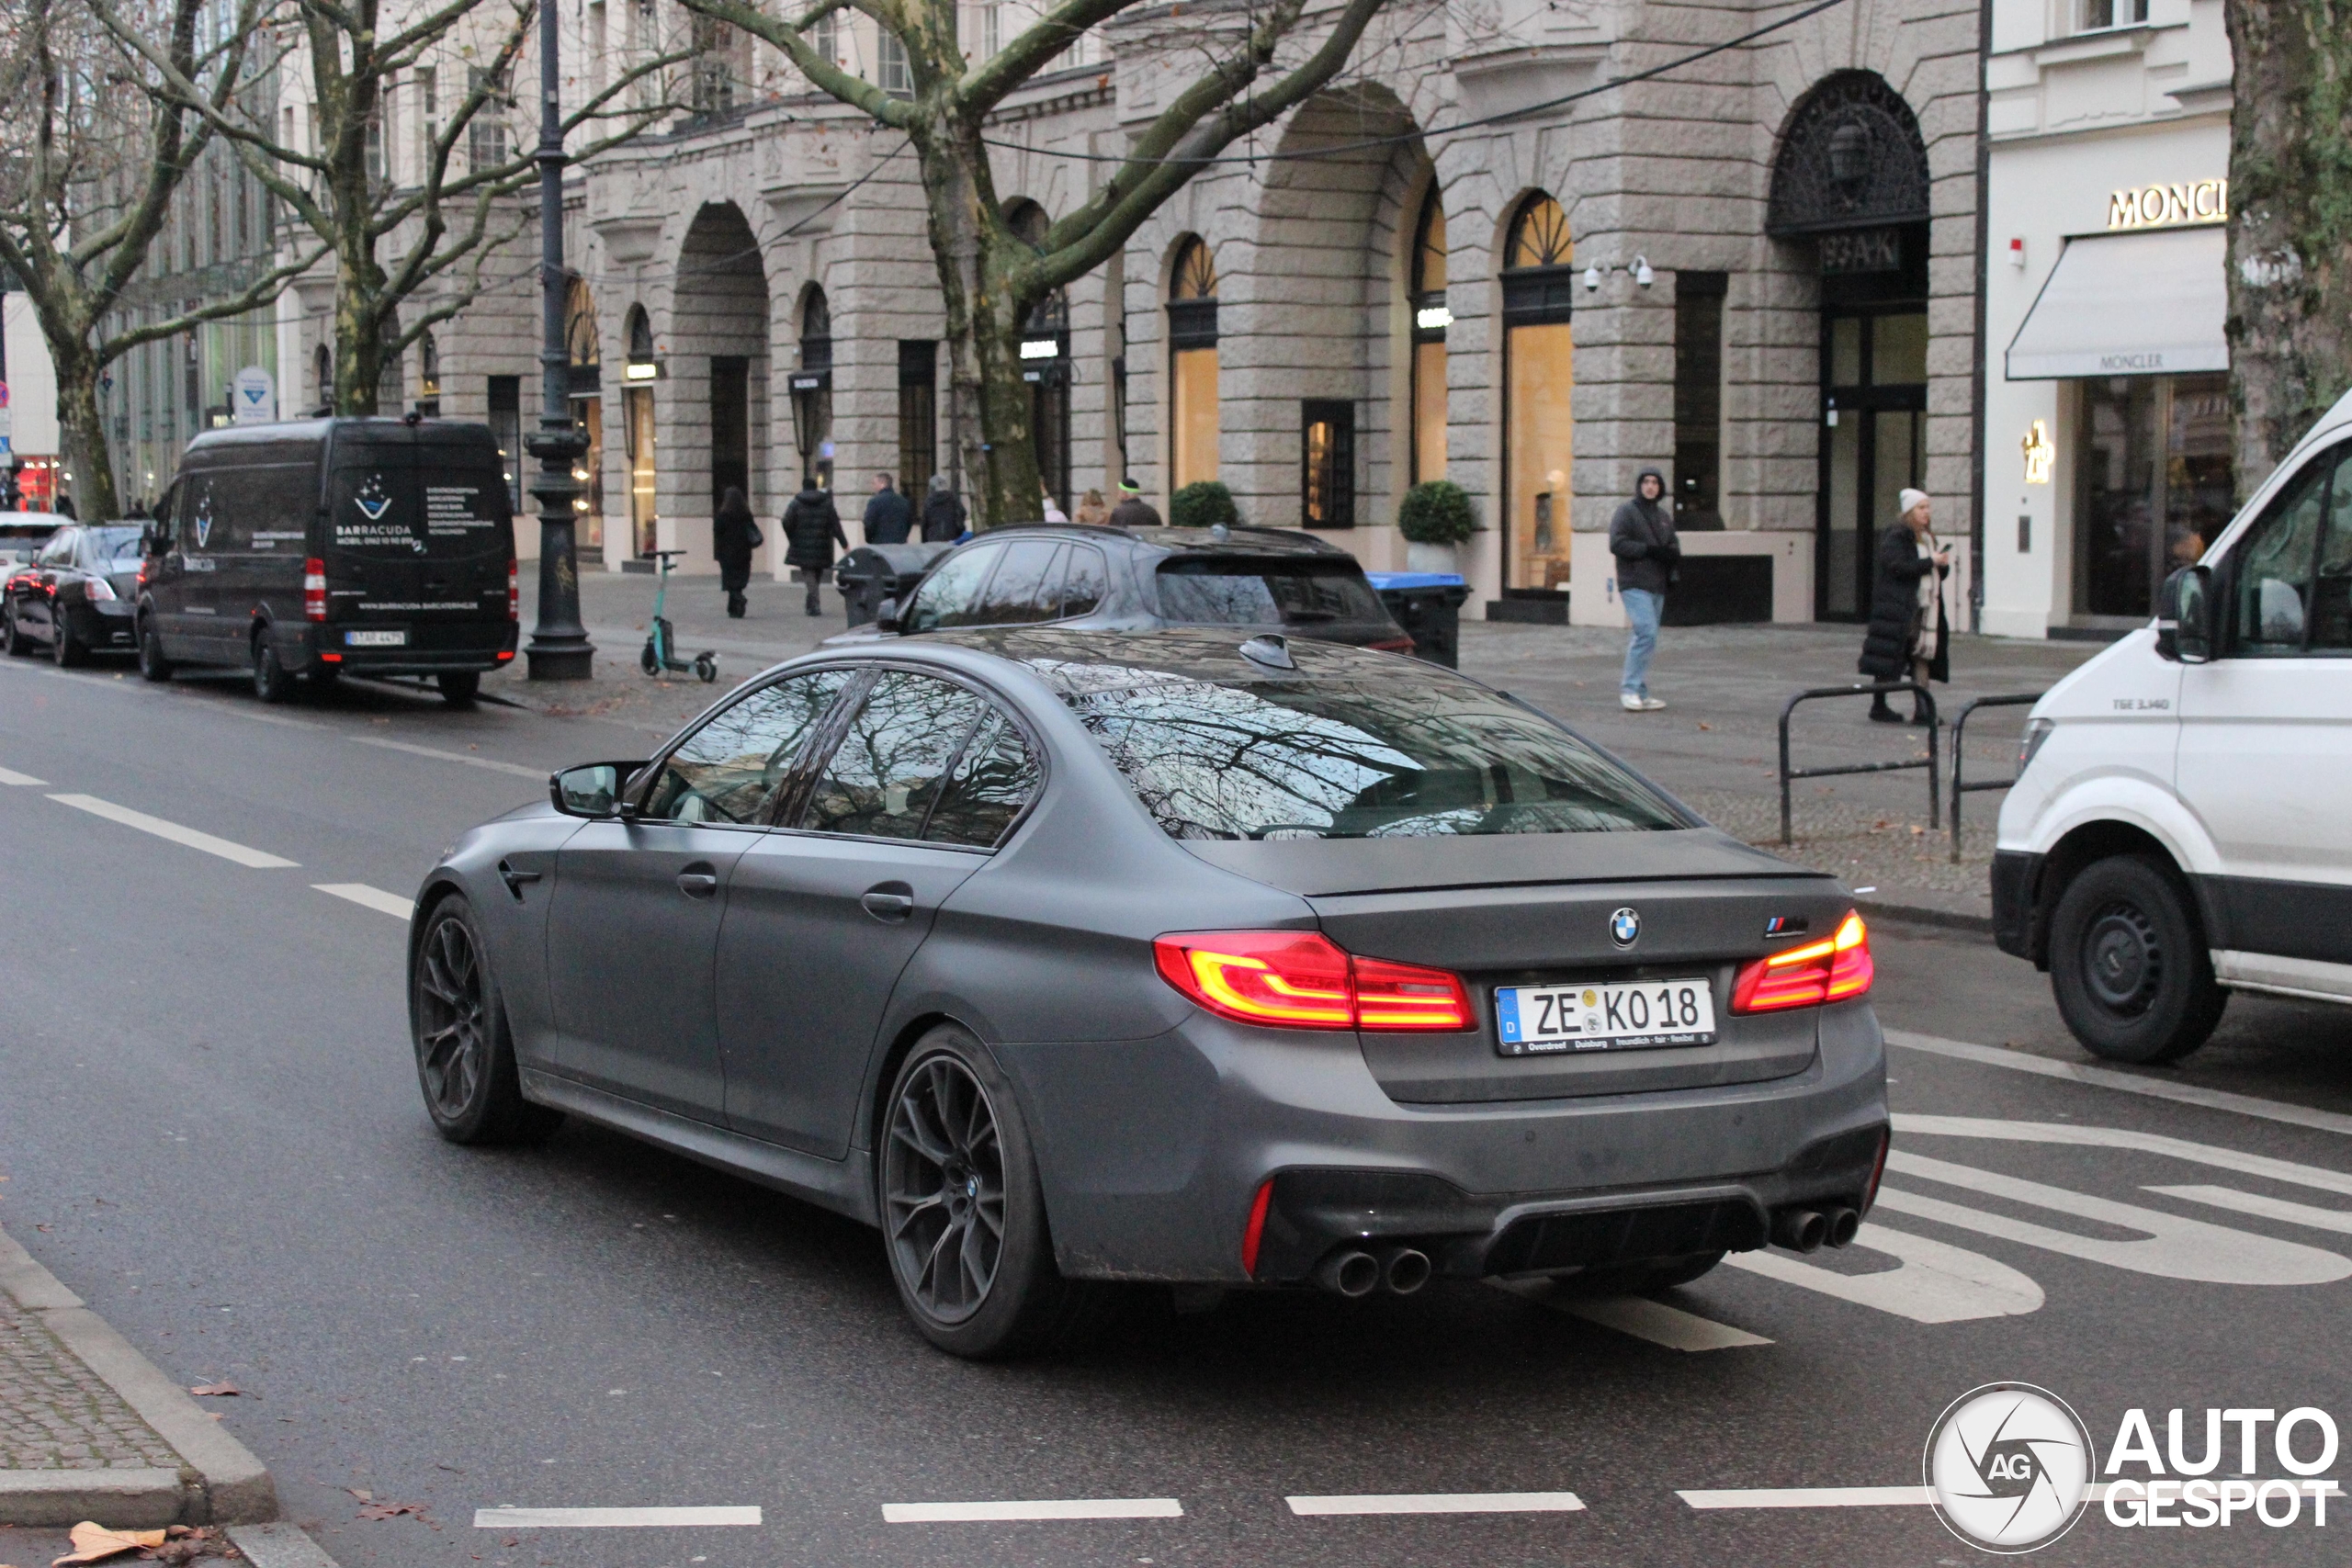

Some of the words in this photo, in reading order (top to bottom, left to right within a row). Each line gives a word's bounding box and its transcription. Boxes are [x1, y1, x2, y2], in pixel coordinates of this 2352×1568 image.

[2098, 354, 2164, 369] MONCLER
[336, 525, 411, 536] BARRACUDA
[1506, 1021, 1516, 1034] D
[1534, 993, 1581, 1034] ZE
[1604, 990, 1649, 1030] KO
[1657, 987, 1699, 1028] 18
[1575, 1039, 1607, 1049] Duisburg
